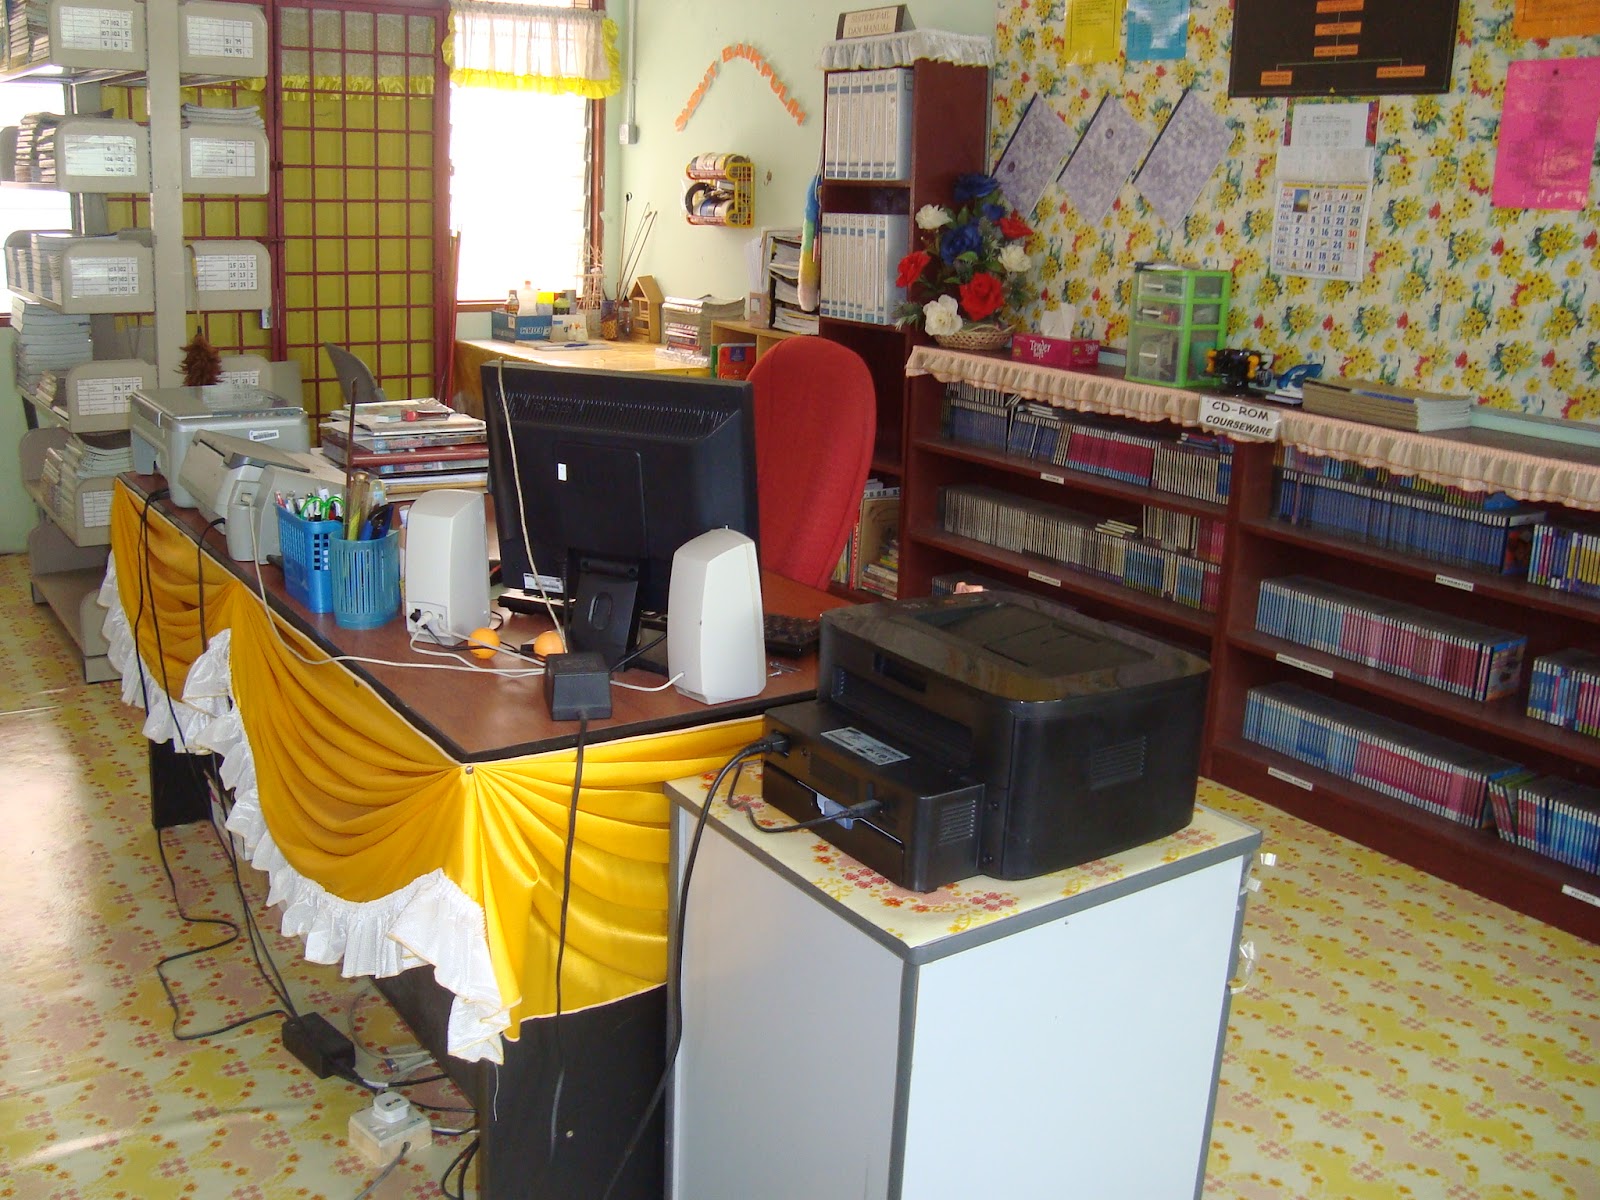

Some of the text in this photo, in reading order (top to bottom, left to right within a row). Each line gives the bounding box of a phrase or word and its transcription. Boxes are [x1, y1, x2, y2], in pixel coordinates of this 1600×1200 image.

[848, 23, 889, 35] DAN MANUAL
[1324, 204, 1332, 212] 14
[1338, 205, 1346, 213] 21
[1323, 216, 1330, 225] 15
[1336, 217, 1344, 226] 22
[1349, 218, 1358, 226] 29
[1322, 228, 1329, 236] 16
[1334, 229, 1343, 237] 23
[1307, 239, 1315, 247] 10
[1347, 242, 1355, 250] 31
[1305, 250, 1312, 259] 11
[1318, 251, 1327, 260] 18
[1332, 253, 1340, 261] 25
[1318, 263, 1326, 272] 19
[1030, 340, 1051, 353] Tender
[1212, 401, 1269, 422] CD-ROM
[1205, 415, 1273, 437] COURSEWARE
[1436, 576, 1472, 590] MATHEMATICS
